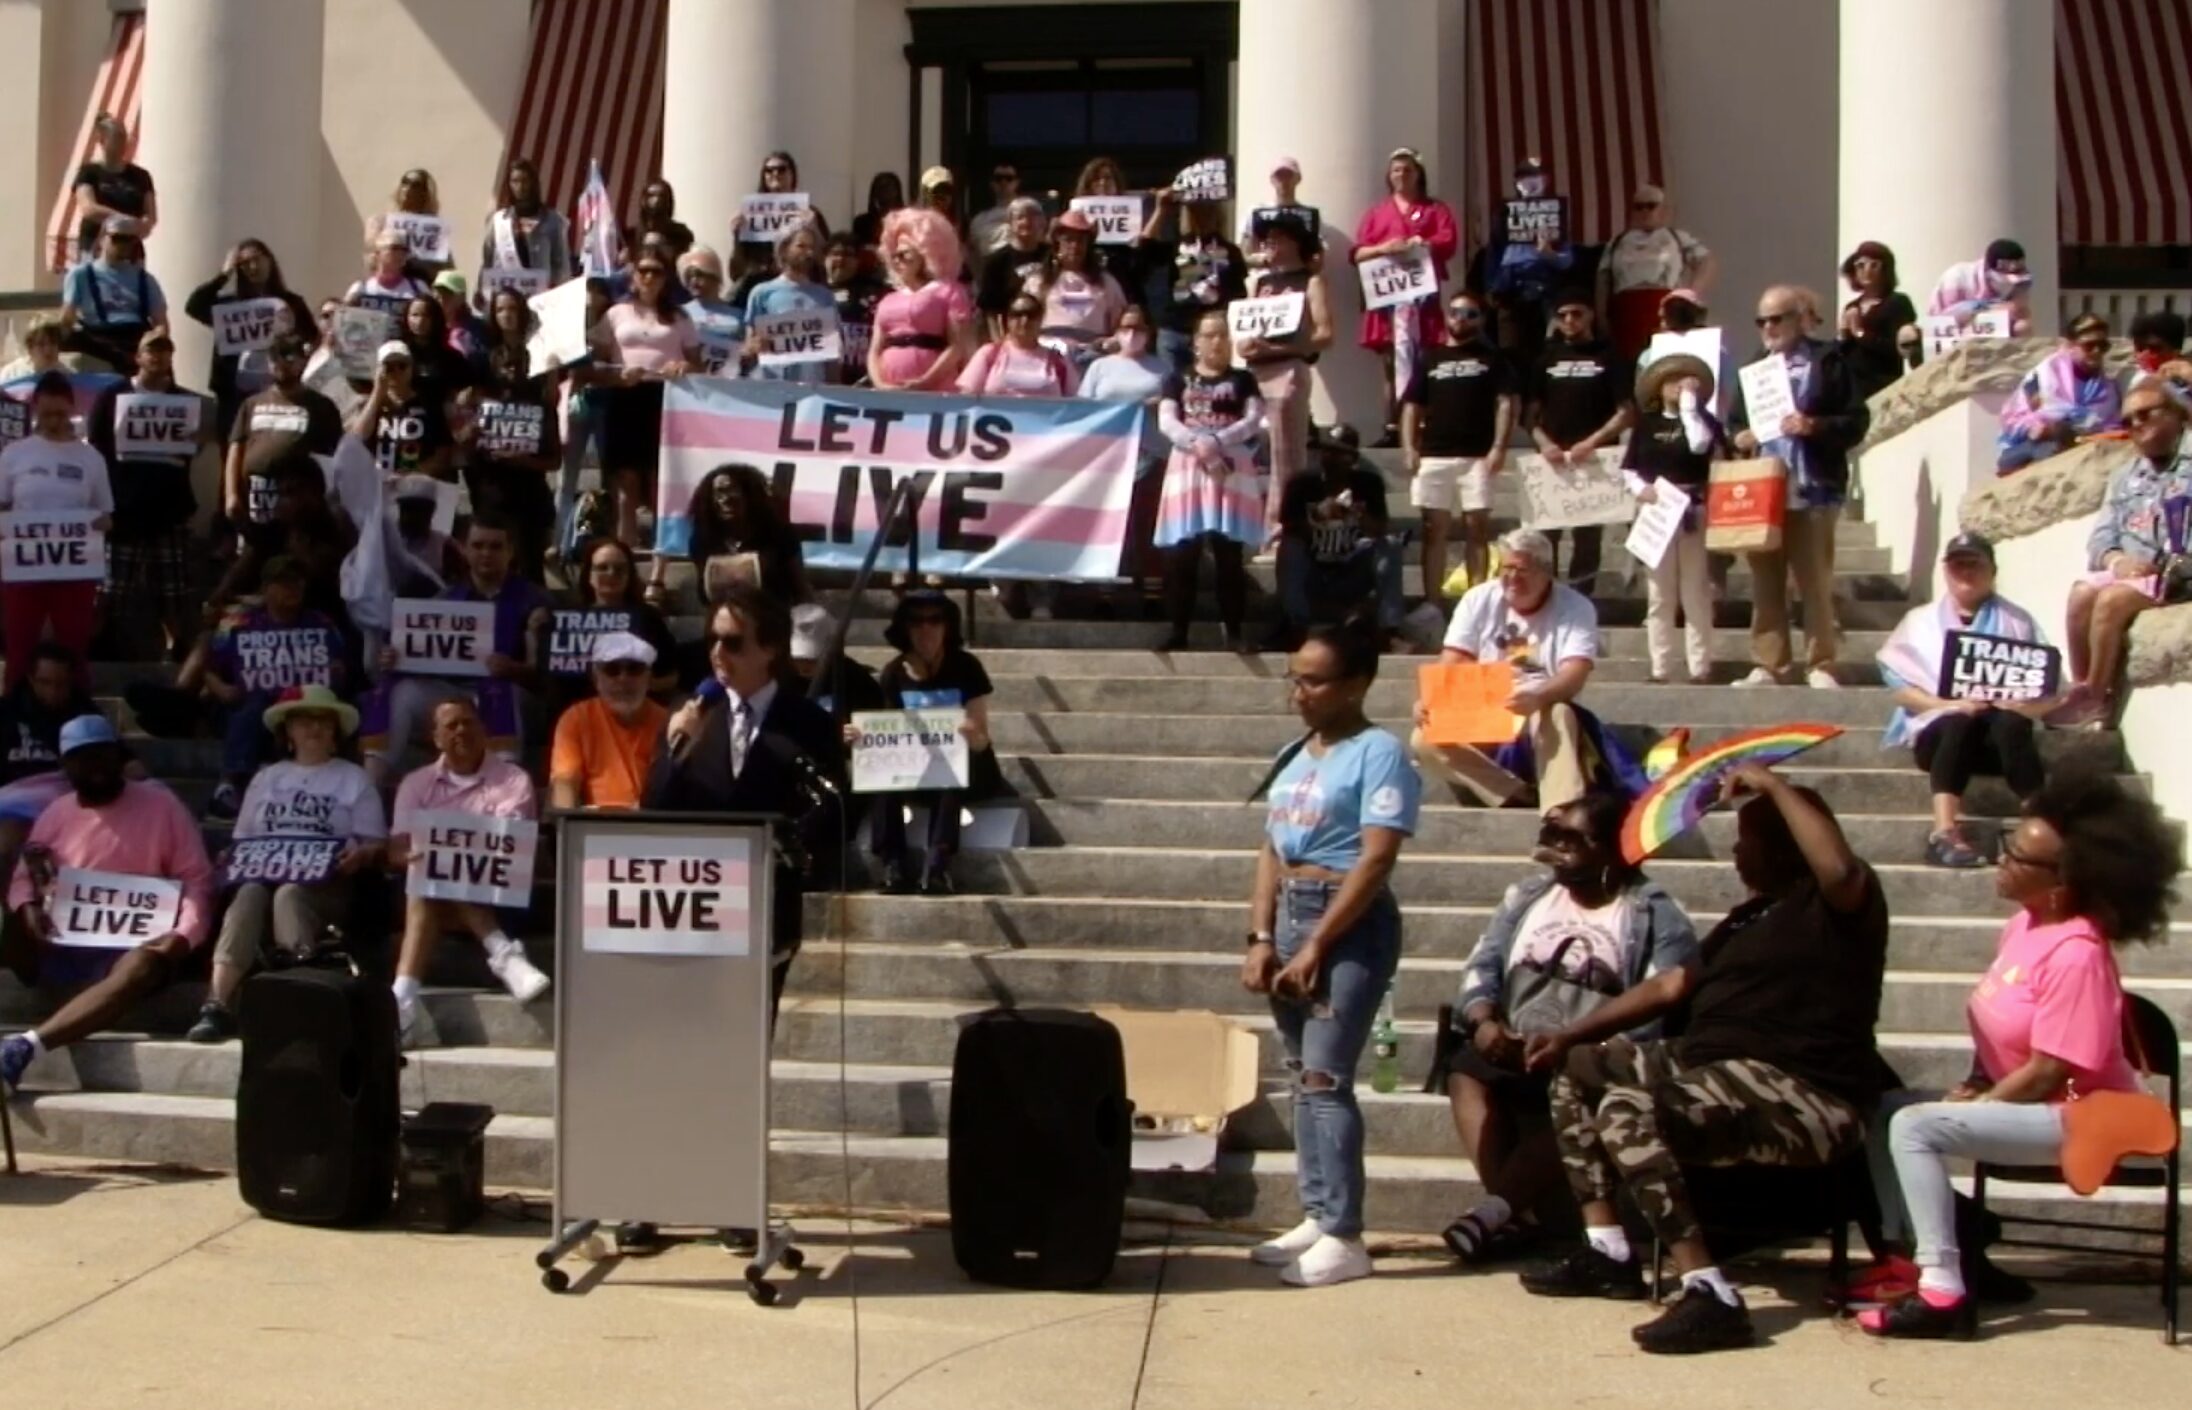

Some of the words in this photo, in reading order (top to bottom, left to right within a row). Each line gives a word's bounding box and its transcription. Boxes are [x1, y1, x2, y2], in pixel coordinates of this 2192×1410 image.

[749, 201, 776, 212] LET
[779, 201, 797, 211] US
[1089, 204, 1105, 214] ET
[1508, 214, 1559, 230] LIVES
[405, 235, 438, 251] IVE
[1375, 272, 1424, 297] LIVE
[766, 322, 797, 335] LET
[802, 319, 823, 332] US
[1236, 315, 1286, 333] LIVE
[1934, 324, 1964, 338] LET
[1975, 322, 1996, 335] US
[769, 334, 824, 353] LIVE
[128, 405, 156, 418] LET
[166, 406, 188, 418] US
[481, 401, 544, 420] TRANS
[127, 421, 186, 440] LIVE
[377, 417, 425, 440] NO
[778, 402, 902, 455] LET
[927, 412, 1013, 461] US
[772, 462, 1003, 552] LIVE
[14, 523, 51, 538] LET
[60, 522, 87, 538] US
[16, 541, 88, 566] LIVE
[406, 613, 442, 629] LET
[451, 615, 476, 632] US
[554, 610, 631, 630] TRANS
[237, 627, 328, 651] PROTECT
[406, 634, 476, 661] LIVE
[550, 632, 596, 654] LIV
[239, 645, 330, 668] TRANS
[549, 656, 593, 672] MAT
[1957, 636, 2049, 670] TRANS
[241, 666, 331, 692] YOUTH
[1952, 659, 2046, 687] LIVES
[1951, 682, 2043, 701] MATTER
[863, 733, 913, 748] DON'T
[920, 733, 954, 747] BAN
[430, 828, 474, 849] LET
[485, 833, 515, 854] US
[427, 850, 513, 887] LIVE
[608, 858, 668, 884] LET
[681, 859, 723, 885] US
[74, 884, 119, 905] LET
[128, 892, 158, 911] US
[608, 889, 720, 931] LIVE
[68, 907, 154, 936] LIVE
